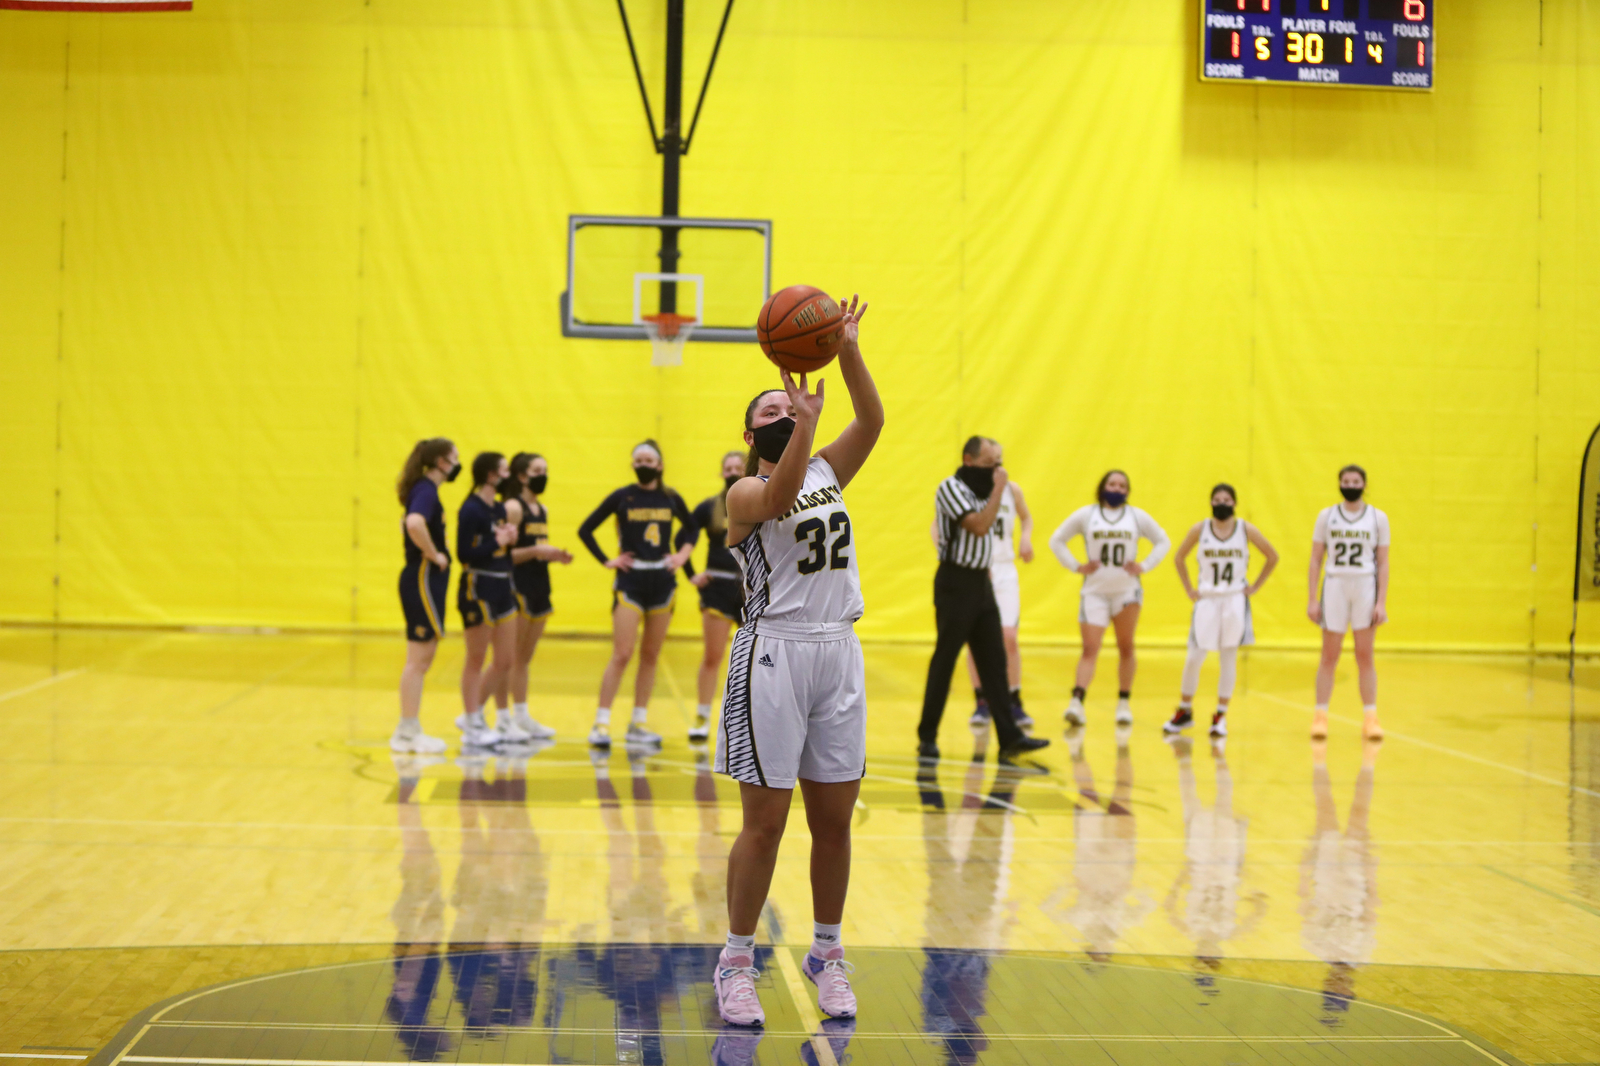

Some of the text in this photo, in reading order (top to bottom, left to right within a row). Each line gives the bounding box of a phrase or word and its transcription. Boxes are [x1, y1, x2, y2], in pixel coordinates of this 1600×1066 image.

[1207, 15, 1245, 29] FOULS
[1282, 17, 1359, 34] PLAYER FOUL
[1393, 23, 1429, 38] FOULS
[1231, 31, 1240, 58] 1
[1286, 32, 1324, 64] 30
[1344, 37, 1353, 63] 1
[1367, 43, 1383, 64] 4
[1417, 40, 1425, 66] 1
[1206, 63, 1244, 77] SCORE
[1298, 67, 1339, 82] MATCH
[1392, 72, 1429, 86] SCORE
[792, 303, 822, 330] THE
[643, 522, 661, 547] 4
[794, 511, 851, 575] 32
[1100, 543, 1126, 567] 40
[1334, 542, 1363, 567] 22
[1211, 562, 1234, 586] 14
